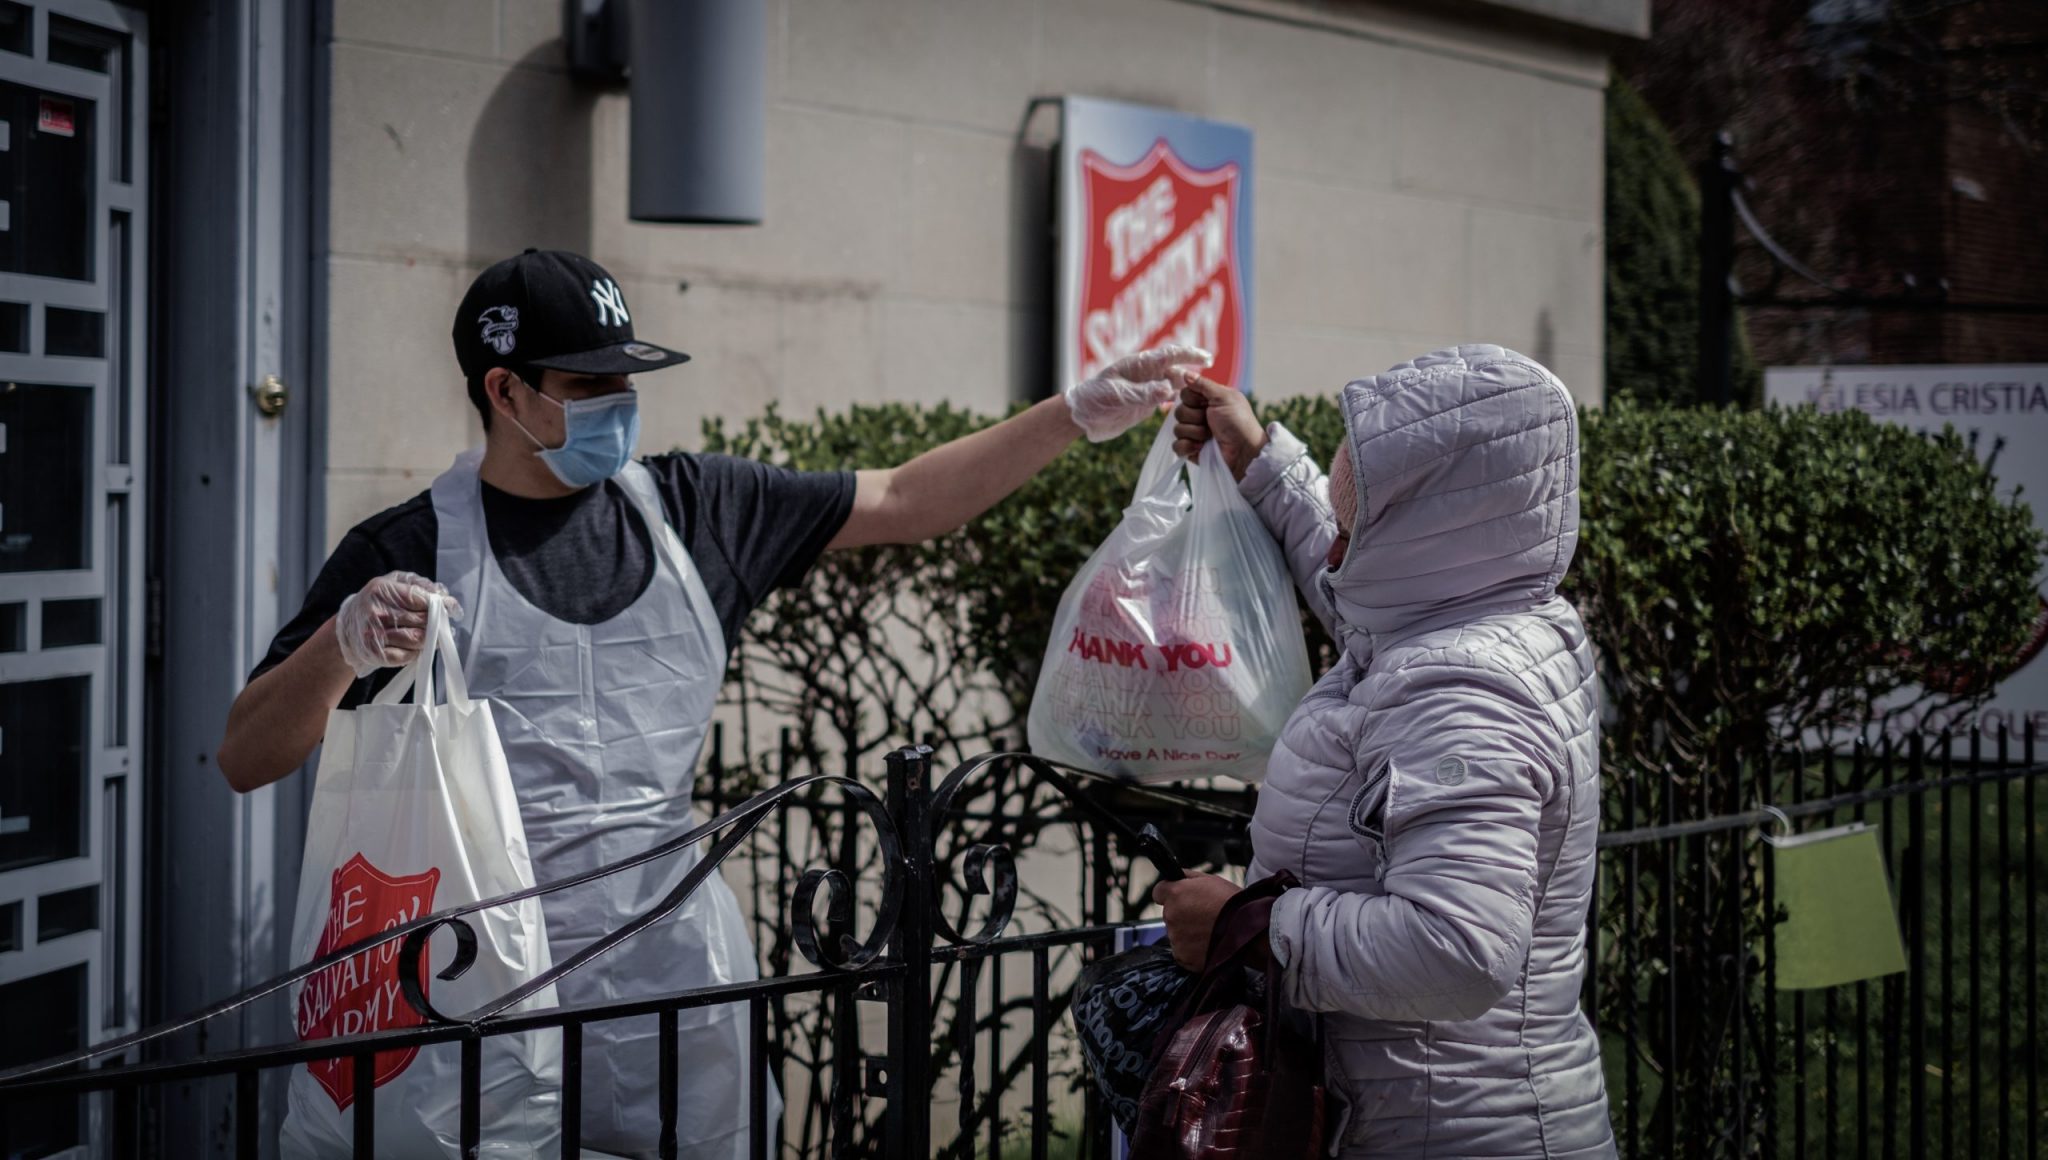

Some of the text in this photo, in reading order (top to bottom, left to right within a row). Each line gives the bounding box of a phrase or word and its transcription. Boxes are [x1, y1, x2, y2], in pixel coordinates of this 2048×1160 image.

[1104, 174, 1176, 281] THE
[1158, 641, 1232, 672] YOU
[1164, 714, 1241, 742] YOU
[1098, 745, 1142, 761] Have
[1146, 747, 1159, 761] A
[1162, 748, 1201, 761] Nice
